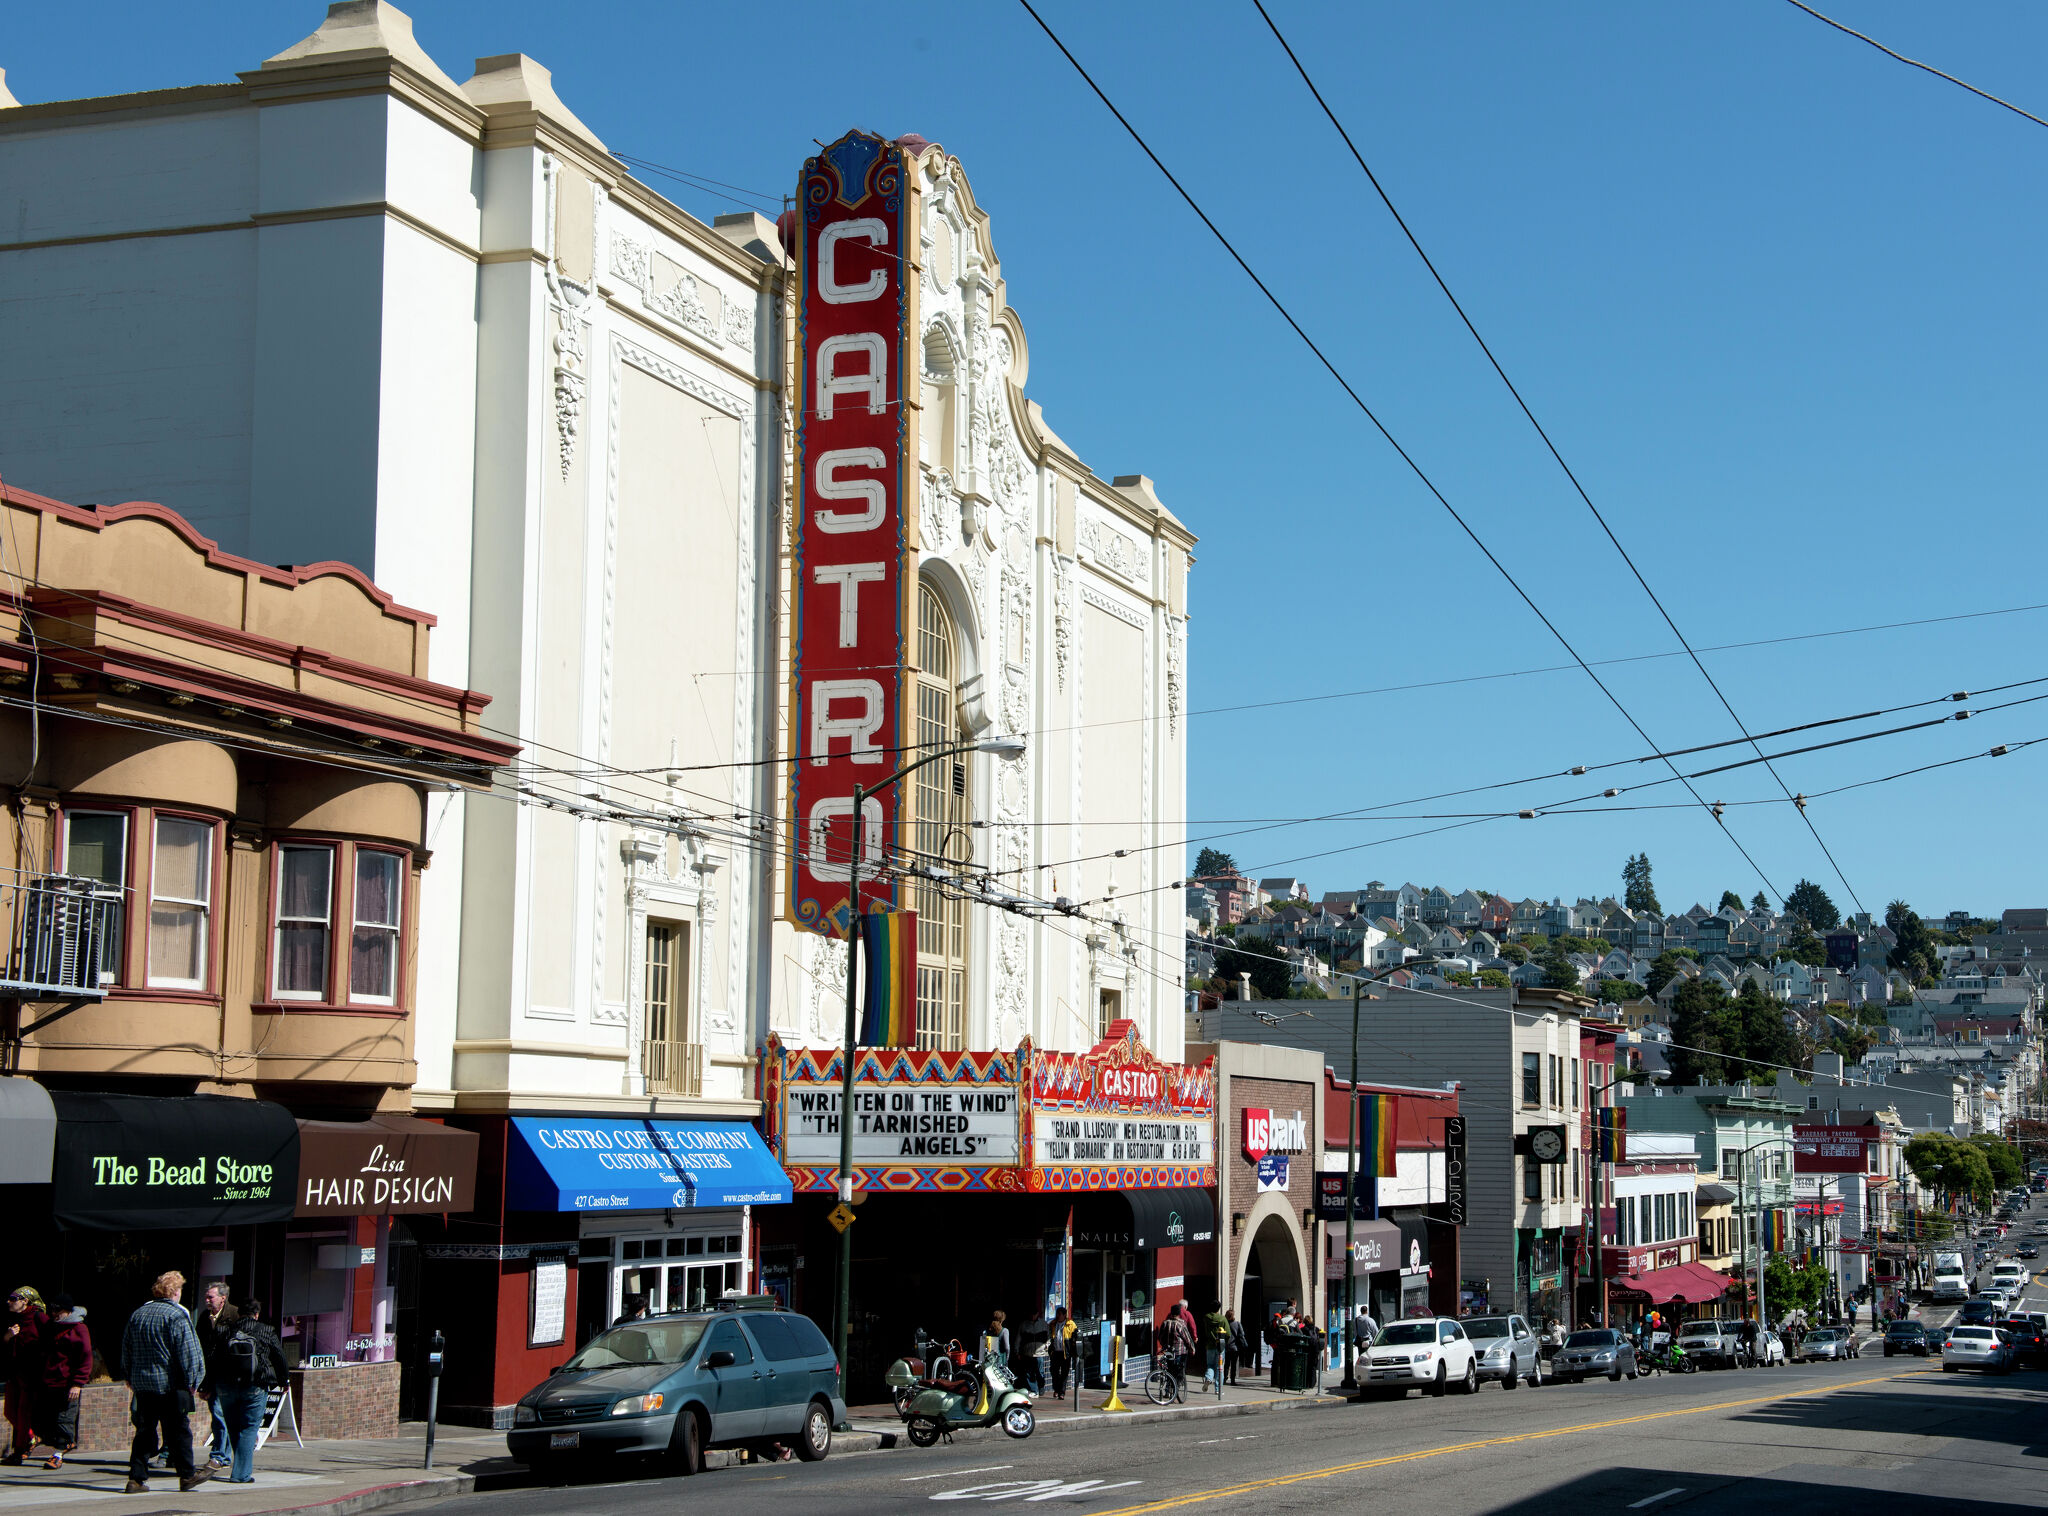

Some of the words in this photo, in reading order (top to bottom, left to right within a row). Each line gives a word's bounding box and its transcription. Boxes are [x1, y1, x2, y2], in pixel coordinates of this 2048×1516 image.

[808, 215, 889, 885] CASTRO
[1104, 1069, 1157, 1098] CASTRO
[790, 1093, 886, 1112] "WRITEN
[892, 1093, 914, 1112] ON
[921, 1094, 952, 1112] THE
[959, 1094, 1016, 1113] WIND"
[802, 1115, 840, 1133] "TH
[859, 1115, 969, 1134] TARNISHED
[1051, 1121, 1080, 1139] "GRAND
[1083, 1121, 1119, 1139] ILLUSION"
[1123, 1123, 1137, 1139] NEW
[538, 1129, 613, 1150] CASTRO
[613, 1130, 680, 1150] COFFEE
[677, 1131, 753, 1150] COMPANY
[900, 1137, 988, 1155] ANGELS"
[360, 1144, 405, 1173] Lisa
[1112, 1142, 1124, 1159] NEW
[599, 1153, 662, 1169] CUSTOM
[664, 1153, 732, 1169] ROASTERS
[93, 1156, 139, 1186] The
[147, 1156, 206, 1186] Bead
[215, 1155, 274, 1185] Store
[659, 1172, 681, 1183] Since
[1448, 1118, 1463, 1225] SLIDERS
[249, 1186, 271, 1199] 1964
[305, 1178, 365, 1206] HAIR
[373, 1176, 454, 1205] DESIGN
[1322, 1180, 1342, 1191] us
[574, 1196, 588, 1208] 427
[588, 1195, 609, 1207] Castro
[610, 1194, 629, 1206] Street
[723, 1192, 782, 1203] www.castro-coffee.com
[1081, 1232, 1129, 1243] NAILS
[312, 1356, 336, 1368] OPEN
